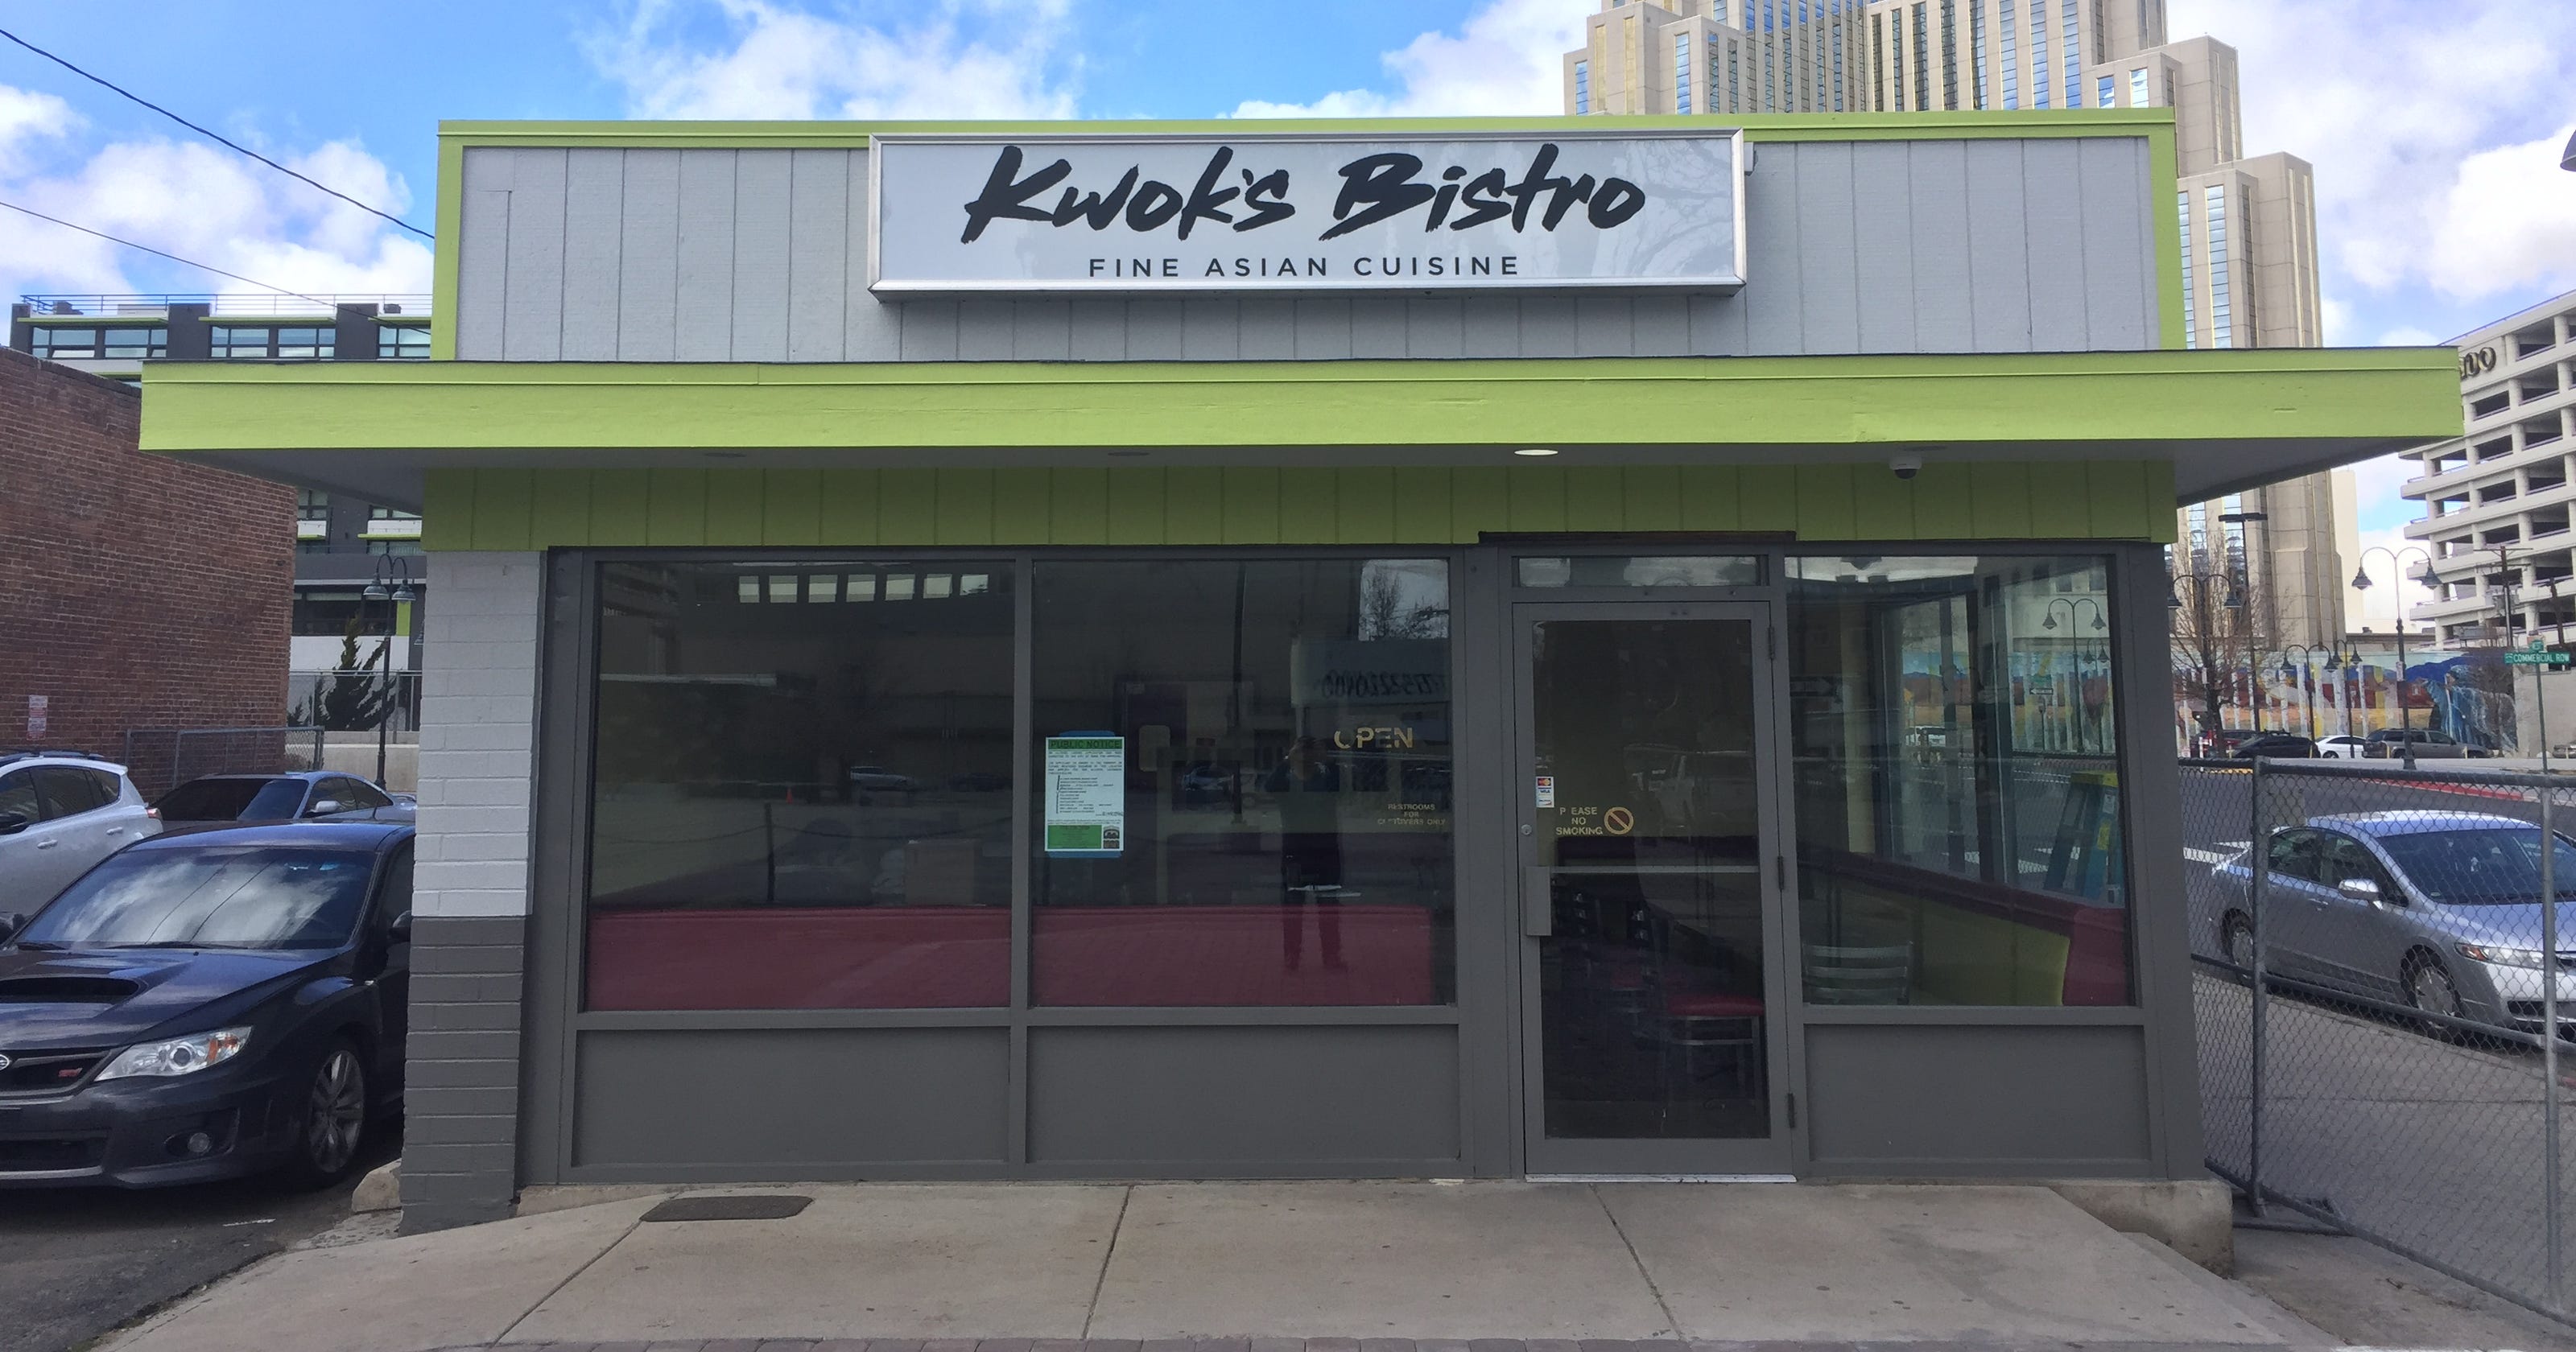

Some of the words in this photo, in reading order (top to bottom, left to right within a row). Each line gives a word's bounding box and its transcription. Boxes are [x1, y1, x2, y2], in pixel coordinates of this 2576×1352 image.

[961, 146, 1296, 245] Kwok's
[1319, 143, 1646, 241] Bistro
[1089, 258, 1179, 278] FINE
[1205, 258, 1327, 278] ASIAN
[1353, 256, 1518, 276] CUISINE
[2512, 653, 2553, 663] COMMERCIAL
[2555, 653, 2570, 663] ROW
[1050, 739, 1085, 749] PUBLIC
[1087, 739, 1120, 749] NOTICE
[1559, 806, 1598, 815] PEASE
[1571, 816, 1587, 826] NO
[1555, 826, 1604, 836] SMOKING
